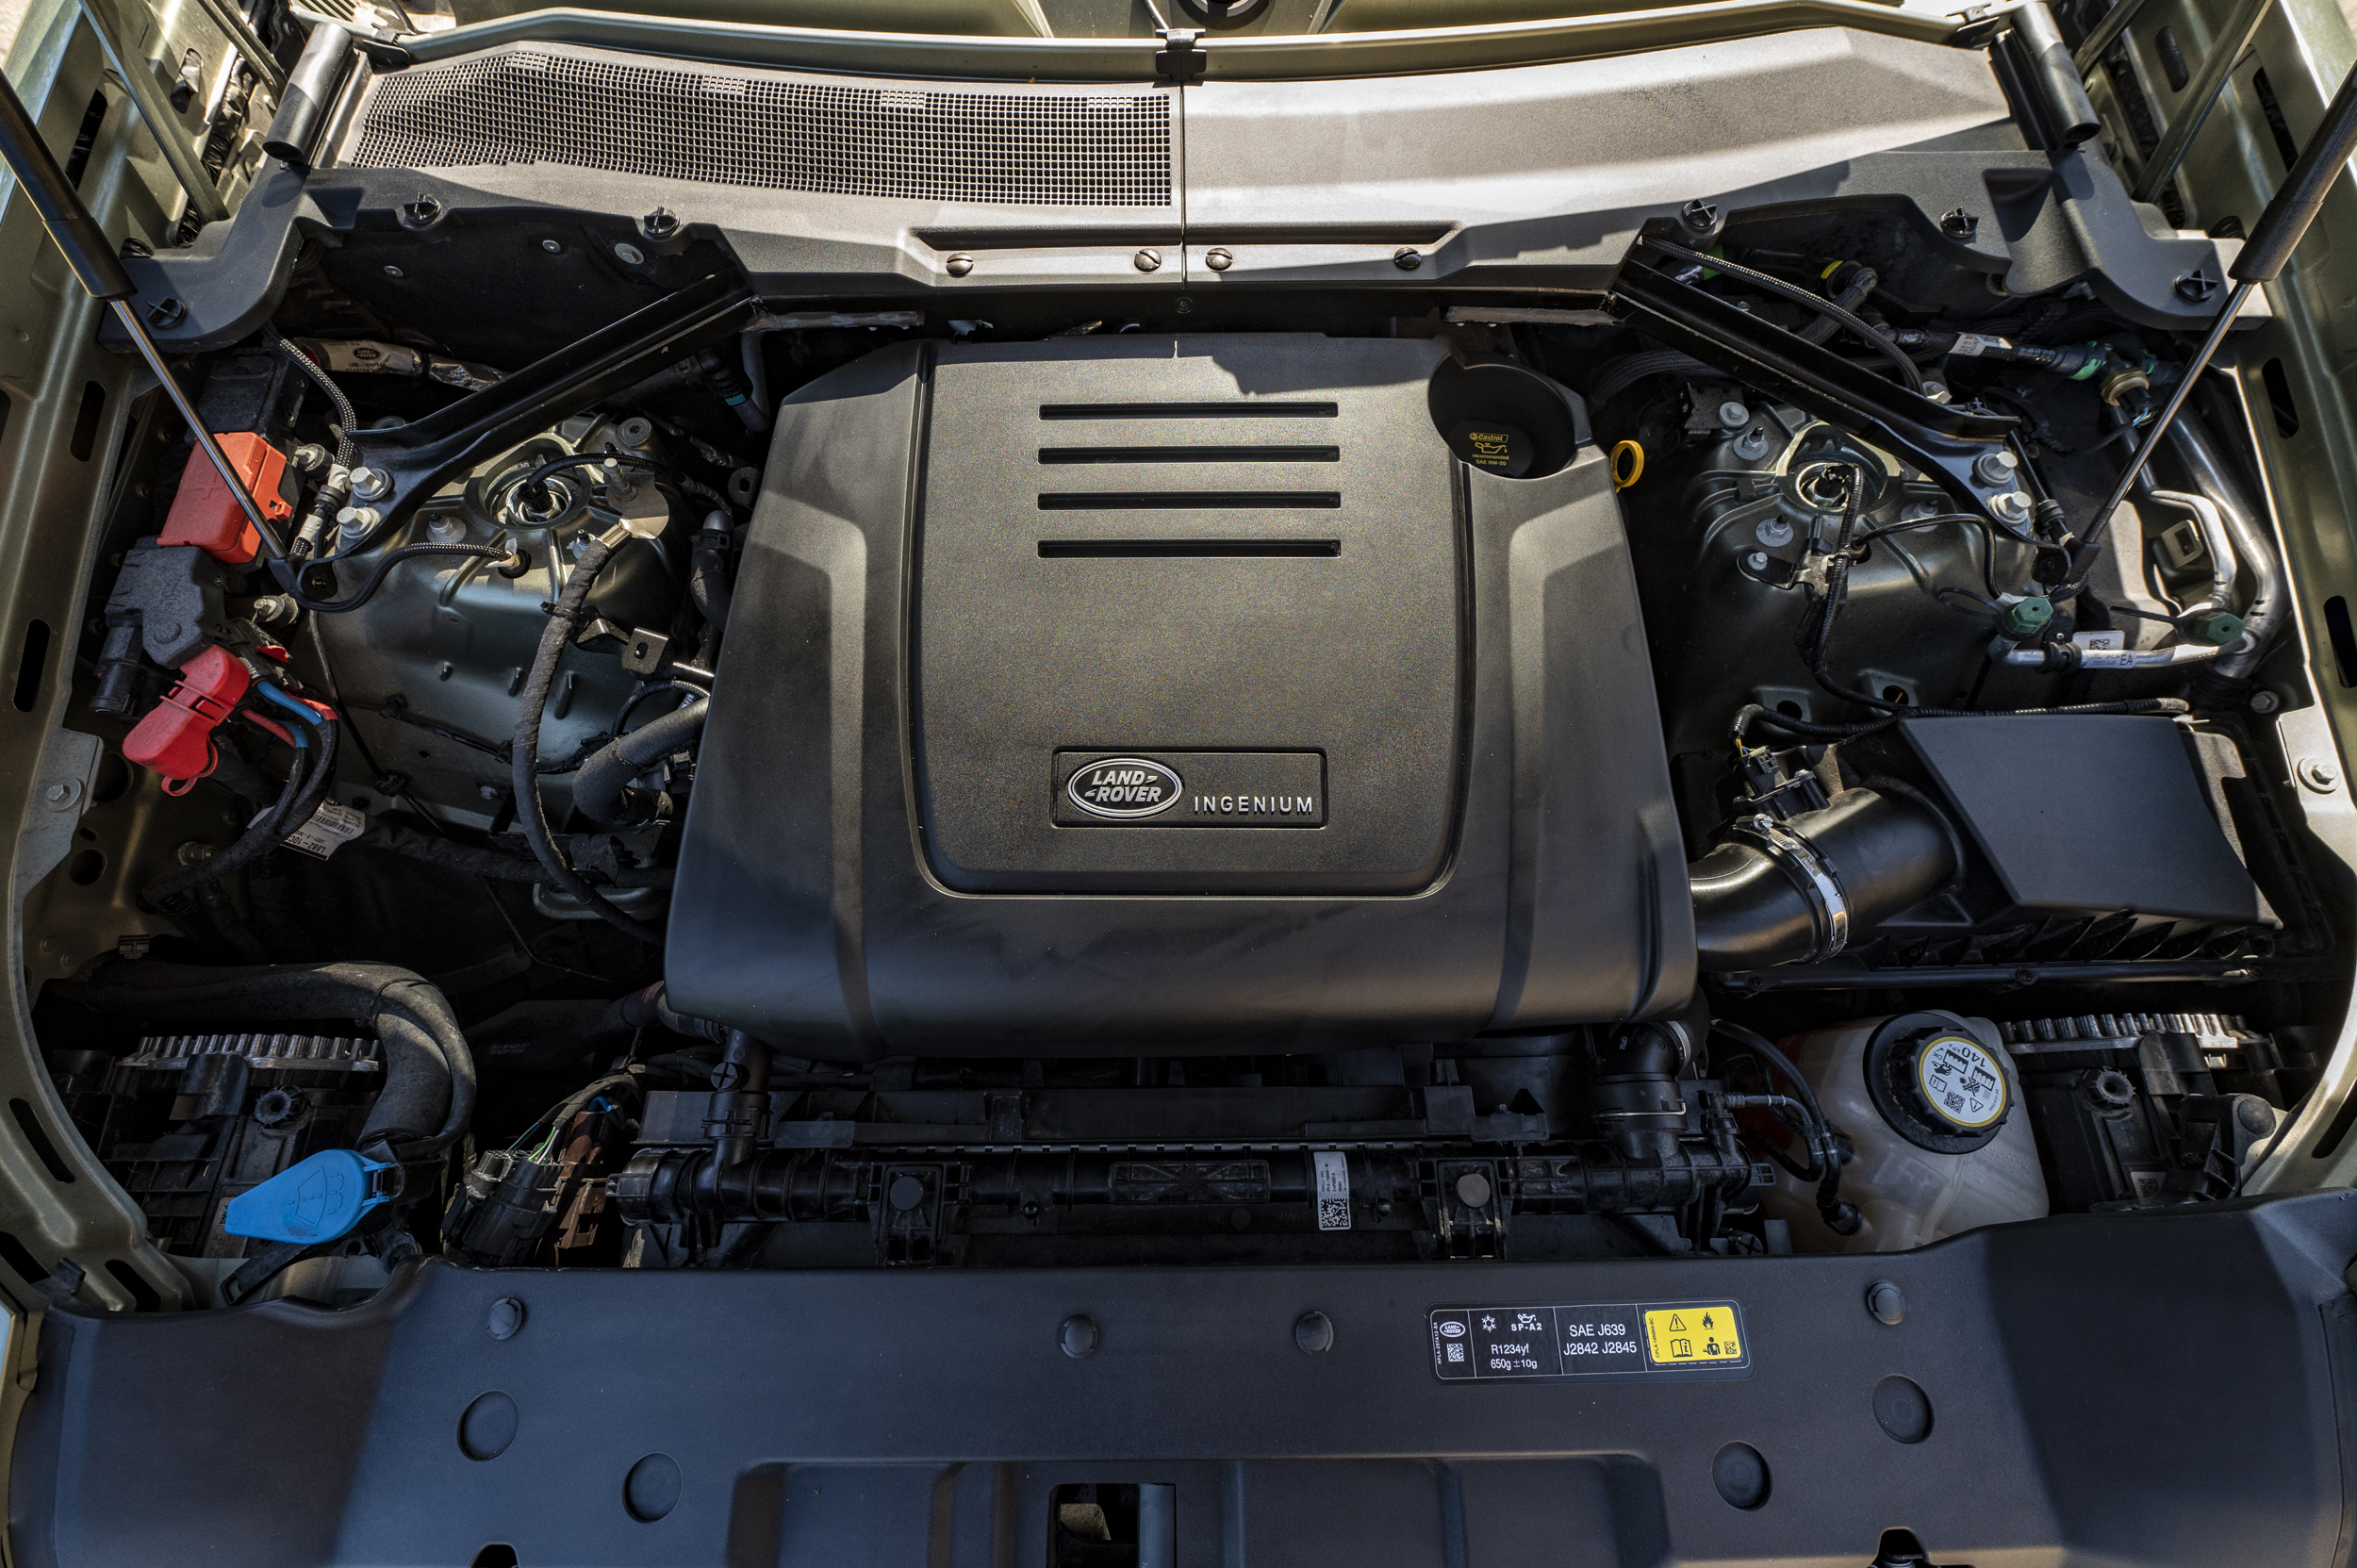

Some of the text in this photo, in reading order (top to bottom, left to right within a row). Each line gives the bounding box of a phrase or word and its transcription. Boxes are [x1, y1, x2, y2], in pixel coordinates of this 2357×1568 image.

[1092, 770, 1145, 785] LAND
[1095, 786, 1162, 802] ROVER
[1194, 796, 1312, 813] INGENIUM
[1933, 1051, 1943, 1060] OK
[1961, 1047, 1986, 1067] 140
[1510, 1322, 1542, 1332] SP-A2
[1569, 1323, 1626, 1337] SAE J639
[1491, 1344, 1530, 1356] R1234yf
[1563, 1341, 1638, 1356] J2842 J2845
[1491, 1358, 1538, 1371] 650g ±10g
